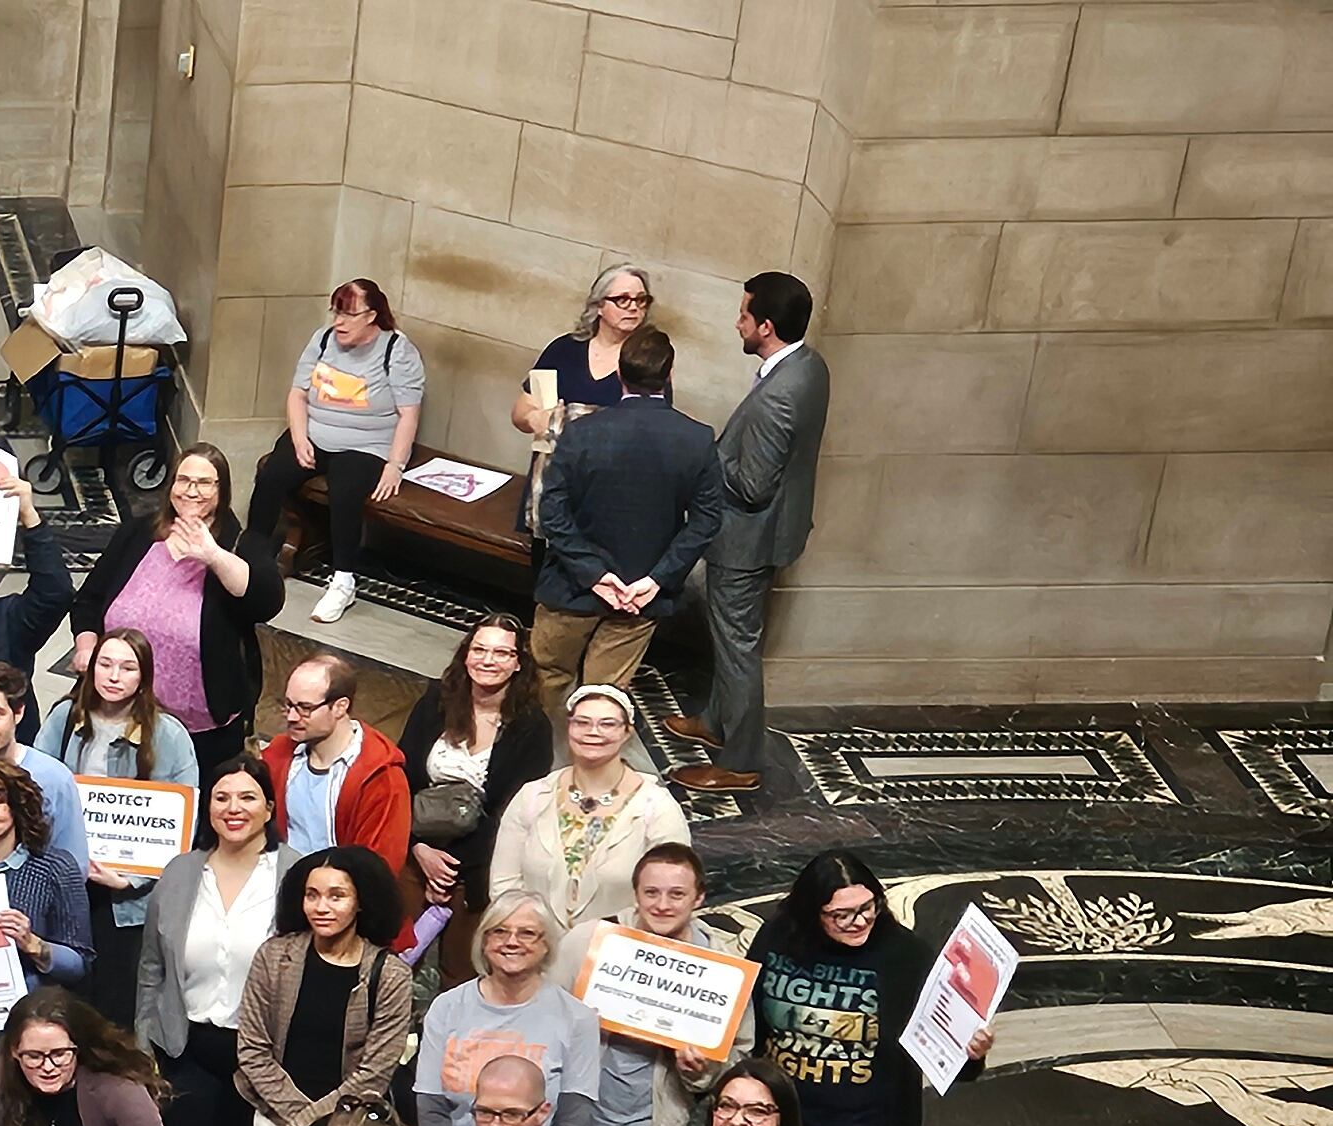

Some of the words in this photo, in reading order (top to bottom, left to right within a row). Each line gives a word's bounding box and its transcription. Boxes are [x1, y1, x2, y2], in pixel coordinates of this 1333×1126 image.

[88, 791, 152, 807] PROTECT
[112, 814, 176, 829] WAIVERS
[634, 949, 708, 978] PROTECT
[599, 962, 654, 986] AD/TBI
[656, 977, 728, 1007] WAIVERS
[763, 971, 878, 1014] RIGHTS
